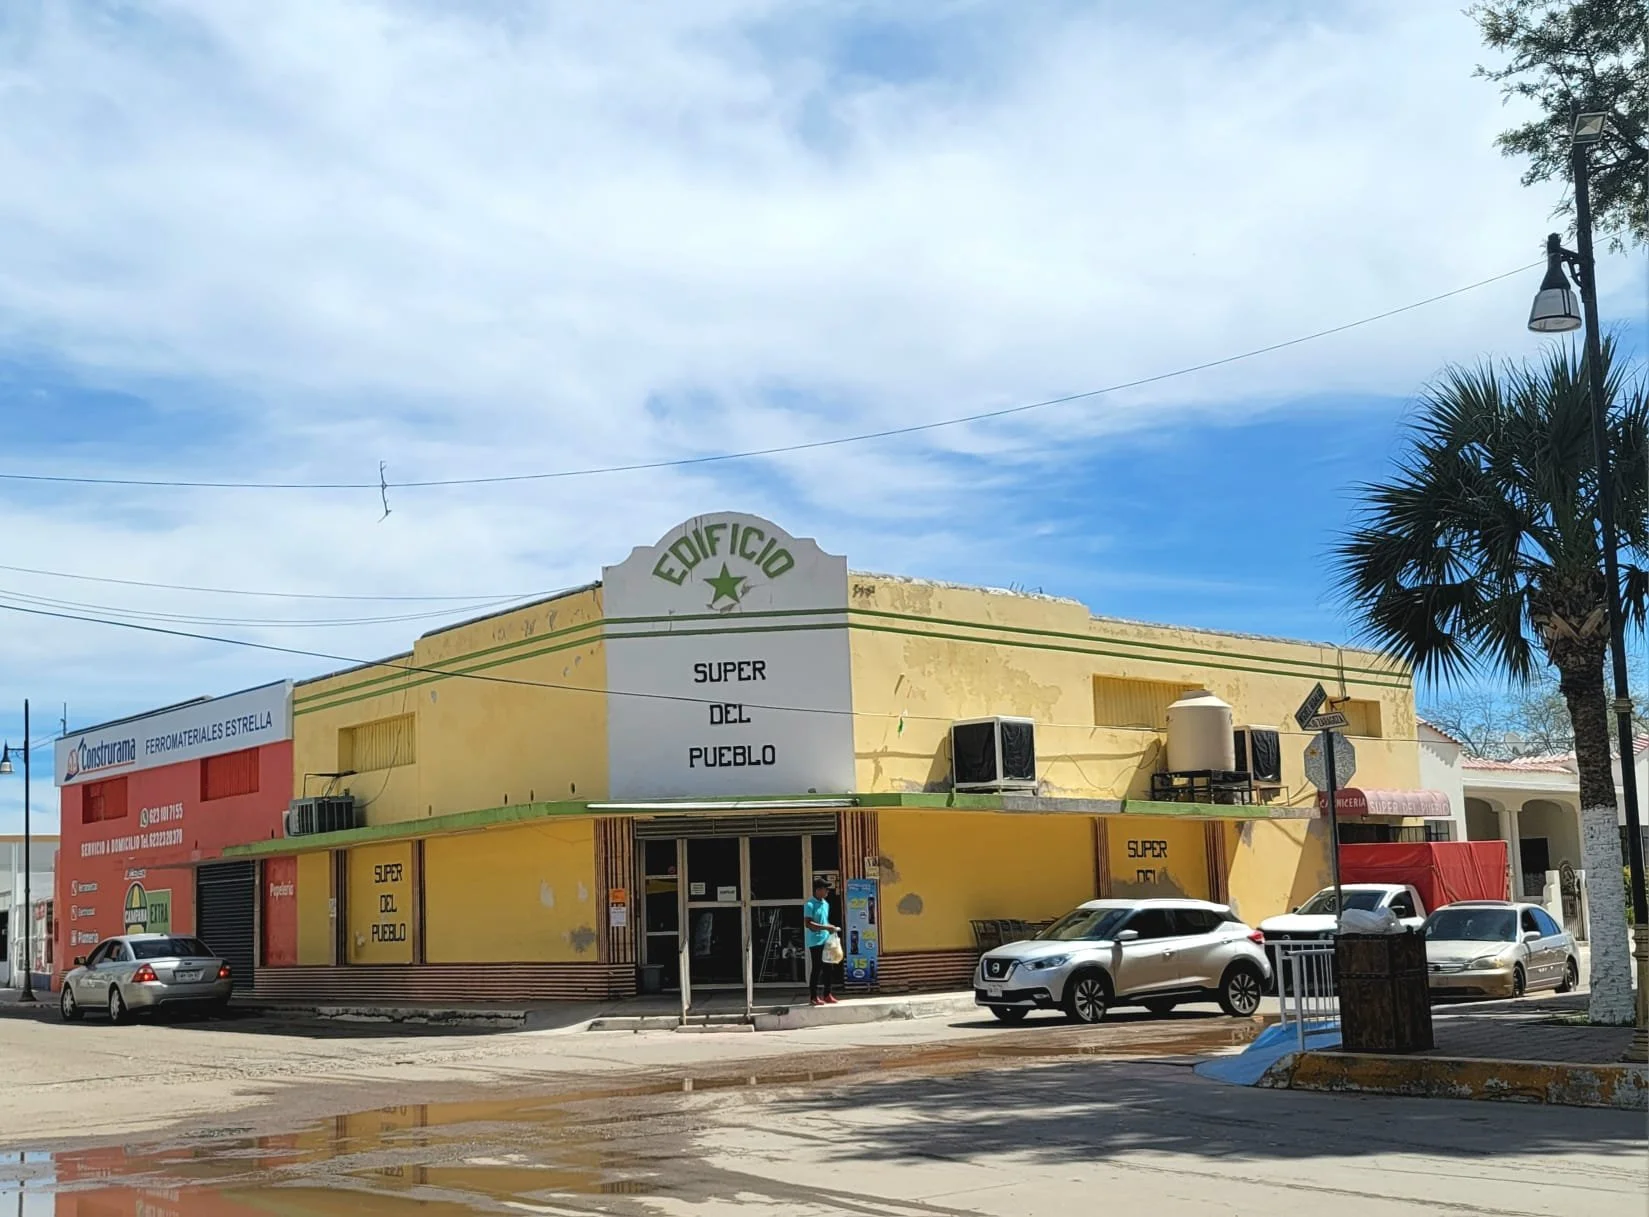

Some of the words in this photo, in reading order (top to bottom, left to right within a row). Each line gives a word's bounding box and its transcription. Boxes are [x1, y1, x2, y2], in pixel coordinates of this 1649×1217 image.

[652, 522, 796, 586] EDIFICIO
[693, 660, 767, 683] SUPER
[709, 703, 751, 725] DEL
[145, 724, 223, 755] FERROMATERIALES
[225, 711, 273, 737] ESTRELLA
[81, 737, 136, 770] Construrama
[688, 744, 776, 768] PUEBLO
[1370, 800, 1399, 814] SUPER
[81, 841, 105, 857] SERVICIO
[106, 840, 110, 854] A
[111, 835, 140, 853] DOMICILIO
[1127, 840, 1168, 858] SUPER
[374, 863, 403, 884] SUPER
[150, 903, 169, 924] EXTRA
[380, 894, 398, 913] DEL
[371, 923, 406, 943] PUEBLO
